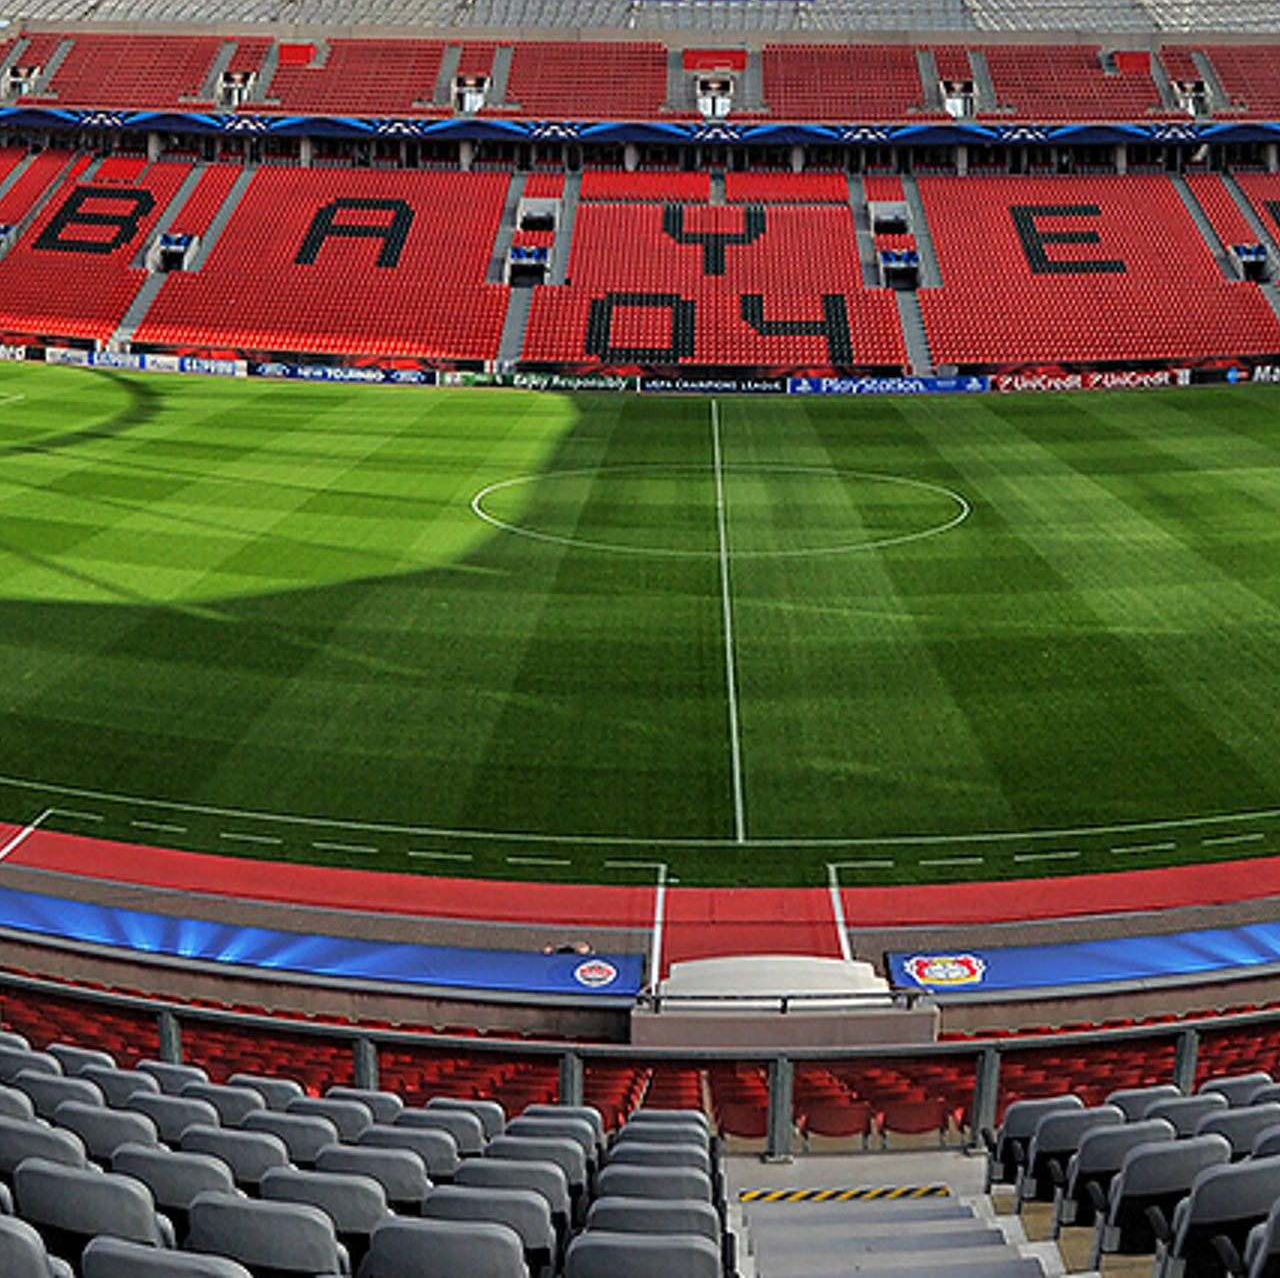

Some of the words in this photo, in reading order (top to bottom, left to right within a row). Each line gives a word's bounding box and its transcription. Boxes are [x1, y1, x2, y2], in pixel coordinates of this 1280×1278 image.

[513, 373, 549, 390] Enjoy
[551, 375, 629, 391] Responsibly
[821, 378, 922, 393] PlayStation
